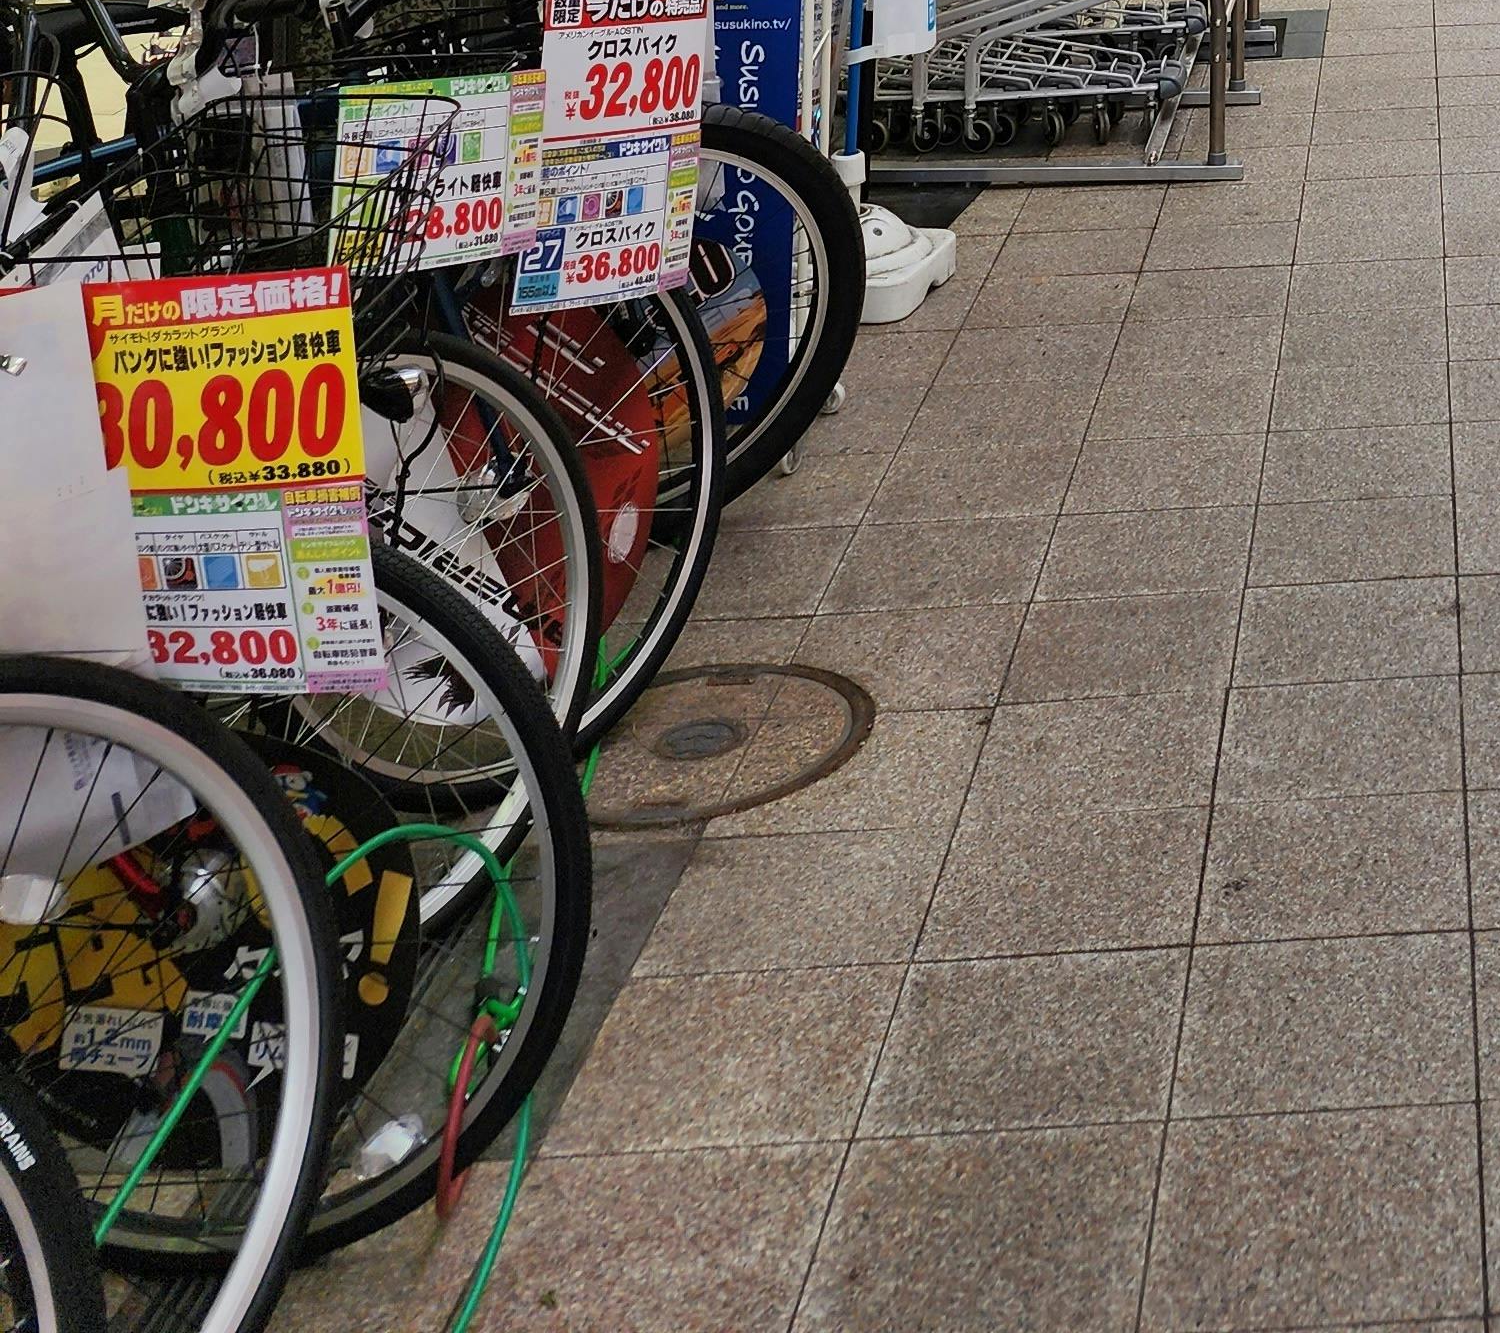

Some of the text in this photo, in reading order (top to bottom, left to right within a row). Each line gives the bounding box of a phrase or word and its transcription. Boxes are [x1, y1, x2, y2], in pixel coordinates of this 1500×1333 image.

[552, 8, 580, 25] 限定
[714, 17, 792, 31] susukino.tv/
[587, 33, 678, 61] クロスバイク
[579, 53, 701, 121] 32,800
[575, 220, 656, 250] クロスバイク
[524, 238, 563, 272] 27
[575, 241, 661, 285] 36,800
[92, 272, 343, 327] 月だけの限定価格!
[146, 628, 298, 665] 32,800
